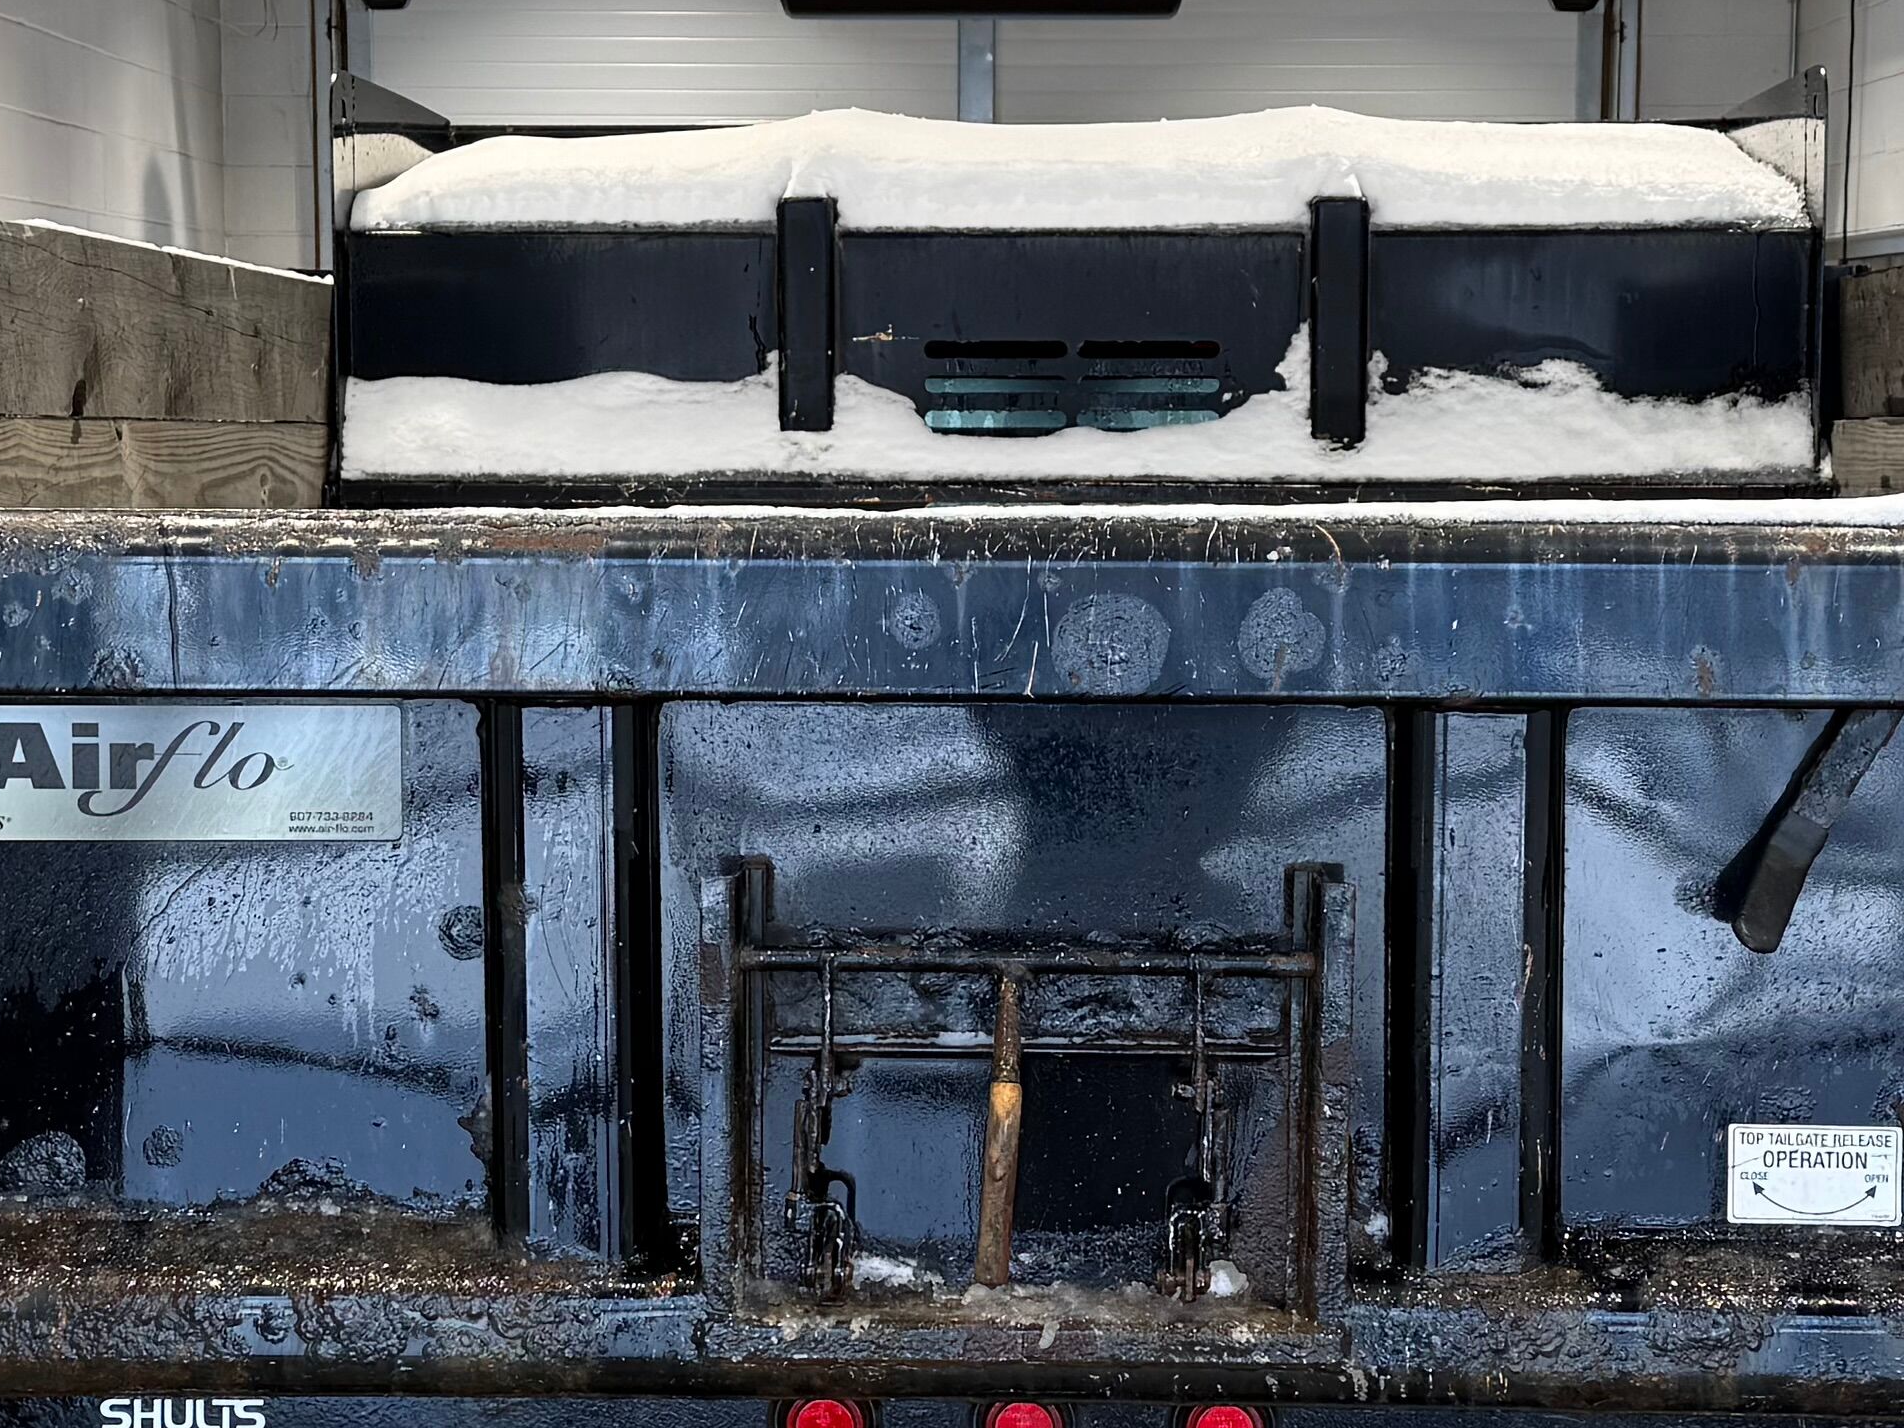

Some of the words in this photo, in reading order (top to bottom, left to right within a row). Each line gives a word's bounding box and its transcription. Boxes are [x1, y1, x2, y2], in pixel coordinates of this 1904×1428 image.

[1739, 1131, 1764, 1145] TOP
[1769, 1132, 1828, 1147] TAILGATE
[1833, 1134, 1893, 1148] RELEASE
[1763, 1149, 1869, 1170] OPERATION
[1739, 1171, 1769, 1181] CLOSE
[1864, 1174, 1889, 1183] OPEN
